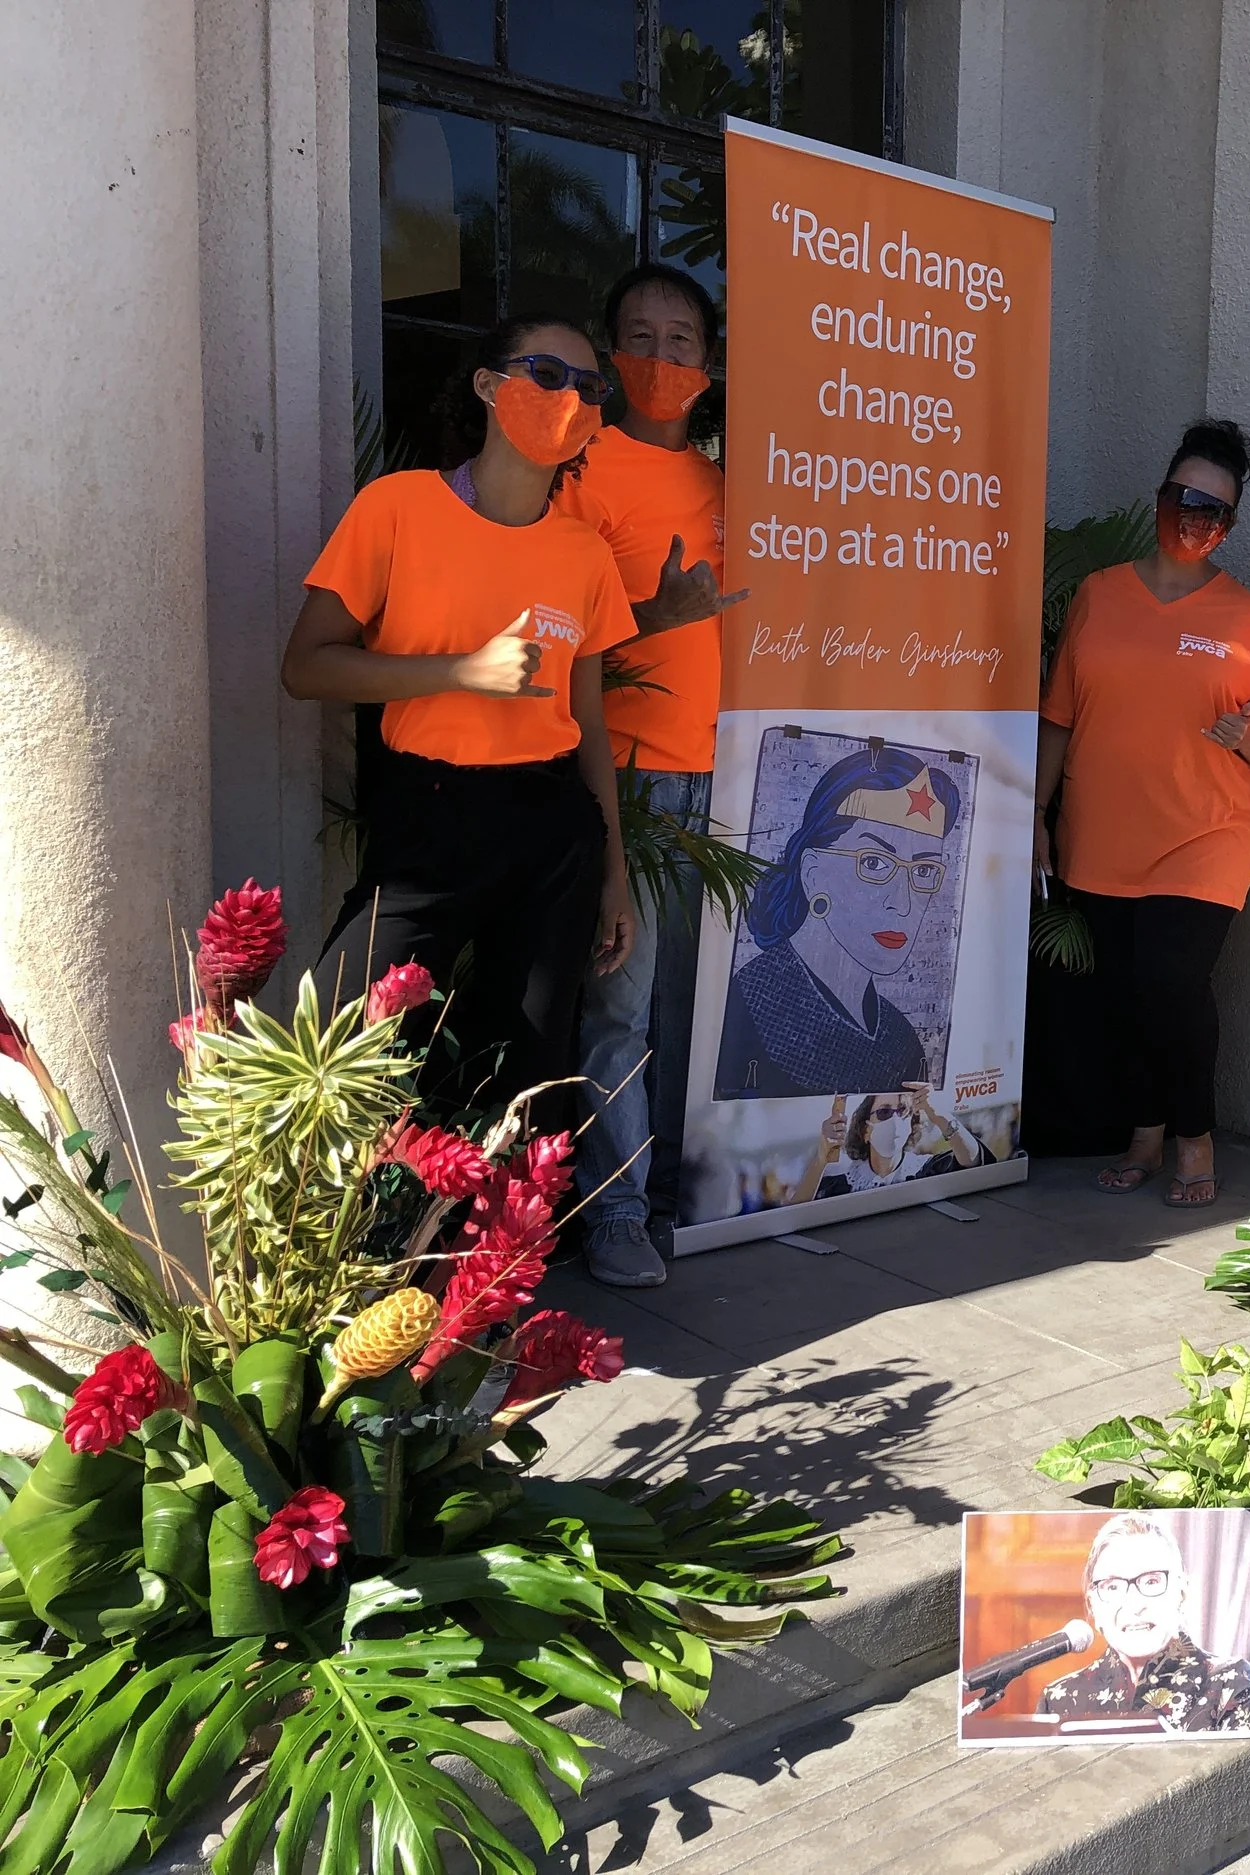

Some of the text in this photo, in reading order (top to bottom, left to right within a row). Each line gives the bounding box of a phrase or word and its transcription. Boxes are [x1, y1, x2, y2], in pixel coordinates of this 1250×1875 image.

[771, 200, 1011, 314] “Real change,
[811, 299, 977, 380] enduring
[818, 367, 962, 444] change,
[767, 432, 1001, 508] happens one
[748, 514, 1009, 576] step at a time.”
[748, 621, 1004, 683] Ruth Bader Ginsburg
[1178, 640, 1226, 659] ywca
[955, 1081, 997, 1103] ywca
